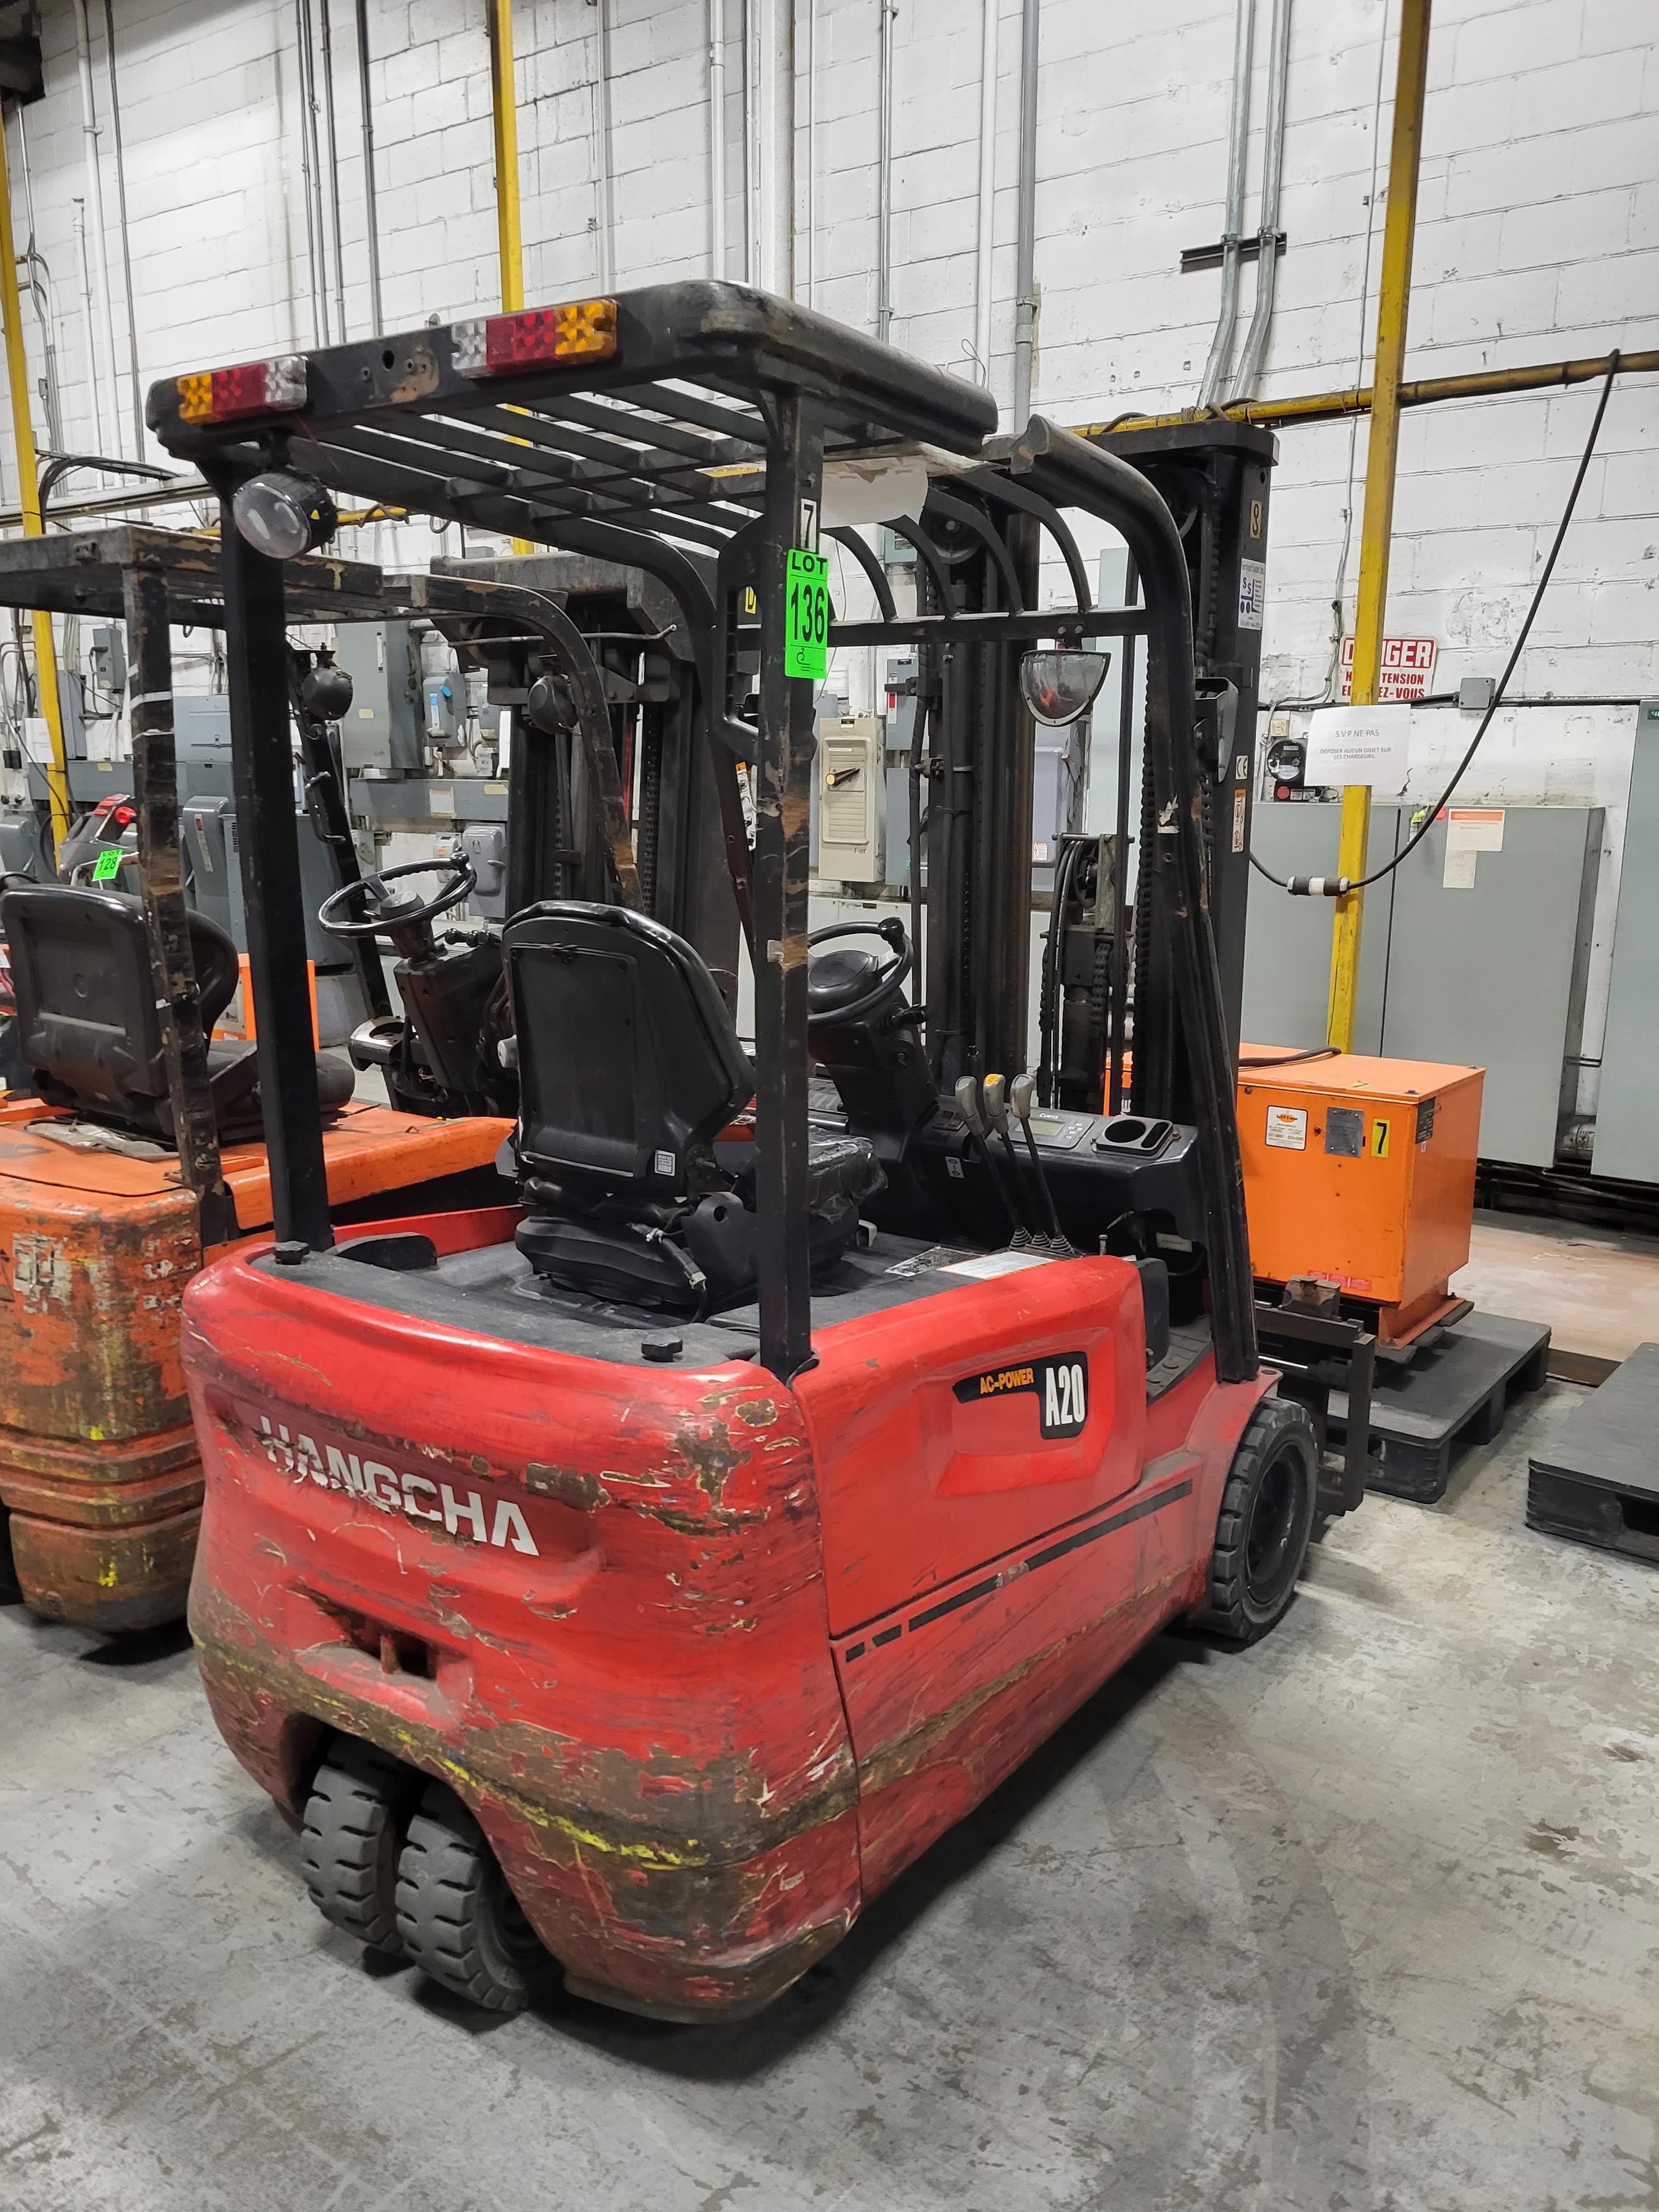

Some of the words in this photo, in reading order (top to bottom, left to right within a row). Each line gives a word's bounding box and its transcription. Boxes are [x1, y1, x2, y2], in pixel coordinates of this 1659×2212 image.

[803, 504, 815, 549] 7
[791, 552, 828, 575] LOT
[791, 581, 826, 644] 136
[1343, 639, 1432, 667] DGER
[1381, 672, 1425, 685] TENSION
[99, 857, 118, 872] 128
[1376, 1121, 1387, 1155] 7
[979, 1367, 1035, 1395] AC-POWER
[1045, 1364, 1086, 1427] A20
[260, 1415, 540, 1556] HANGCHA
